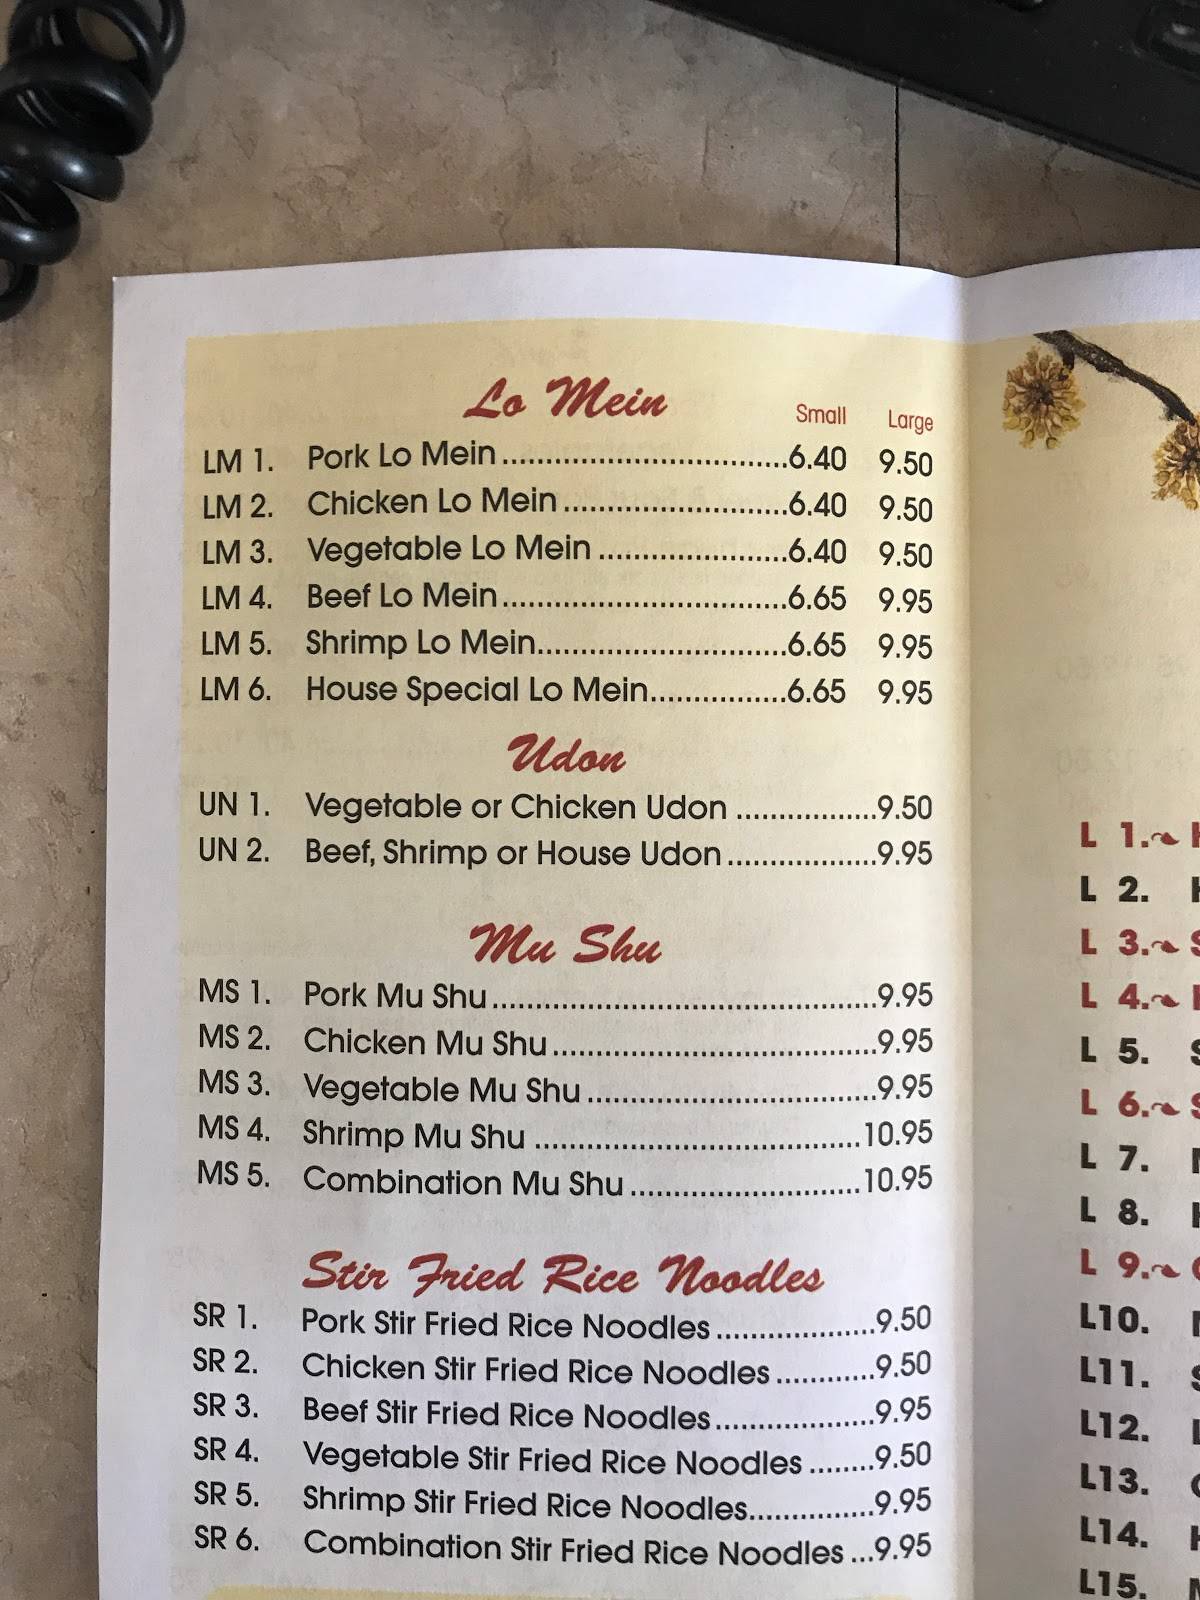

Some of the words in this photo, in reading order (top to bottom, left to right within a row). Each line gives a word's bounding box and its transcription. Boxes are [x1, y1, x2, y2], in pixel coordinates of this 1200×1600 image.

[462, 376, 527, 419] Lo
[545, 375, 669, 419] Mein
[796, 403, 847, 425] Small
[888, 409, 934, 436] Large
[203, 448, 242, 475] LM
[254, 447, 274, 473] 1.
[308, 443, 371, 471] Pork
[379, 442, 412, 468] Lo
[421, 439, 496, 467] Mein
[788, 443, 847, 472] 6.40
[878, 448, 933, 478] 9.50
[203, 493, 242, 520] LM
[250, 492, 273, 519] 2.
[307, 488, 428, 517] Chicken
[438, 487, 472, 514] Lo
[481, 486, 557, 513] Mein
[788, 490, 847, 519] 6.40
[878, 494, 933, 523] 9.50
[202, 539, 241, 565] LM
[249, 538, 273, 565] 3.
[306, 534, 463, 569] Vegetable
[471, 534, 506, 561] Lo
[515, 533, 591, 561] Mein
[788, 537, 847, 565] 6.40
[878, 540, 933, 569] 9.50
[202, 584, 241, 611] LM
[248, 584, 272, 610] 4.
[307, 582, 372, 609] Beef
[379, 581, 414, 608] Lo
[423, 581, 497, 608] Mein
[787, 584, 847, 611] 6.65
[878, 586, 933, 615] 9.95
[201, 630, 240, 656] LM
[248, 630, 272, 657] 5.
[305, 628, 408, 661] Shrimp
[417, 628, 451, 655] Lo
[460, 628, 536, 656] Mein
[787, 630, 847, 658] 6.65
[878, 632, 933, 660] 9.95
[200, 676, 240, 702] LM
[248, 676, 271, 702] 6.
[307, 675, 398, 702] House
[405, 675, 519, 707] Special
[529, 675, 564, 702] Lo
[573, 675, 648, 703] Mein
[787, 677, 846, 704] 6.65
[877, 678, 933, 706] 9.95
[507, 732, 627, 774] Udon
[199, 790, 238, 817] UN
[249, 791, 270, 817] 1.
[304, 791, 463, 825] Vegetable
[471, 798, 503, 819] or
[510, 793, 636, 820] Chicken
[646, 794, 727, 820] Udon
[877, 794, 933, 821] 9.50
[1120, 821, 1149, 849] 1.
[199, 836, 238, 862] UN
[246, 836, 270, 863] 2.
[306, 837, 376, 868] Beef,
[382, 838, 488, 871] Shrimp
[496, 844, 529, 866] or
[537, 839, 631, 866] House
[641, 840, 721, 867] Udon
[877, 840, 933, 866] 9.95
[469, 922, 557, 965] Mu
[572, 923, 663, 964] Shu
[1118, 928, 1150, 957] 3.
[199, 977, 240, 1004] MS
[250, 979, 271, 1005] 1.
[304, 980, 368, 1008] Pork
[377, 982, 423, 1009] Mu
[432, 982, 487, 1010] Shu
[877, 981, 934, 1009] 9.95
[1117, 1037, 1149, 1065] 5.
[198, 1068, 240, 1095] MS
[247, 1070, 270, 1097] 3.
[303, 1072, 460, 1107] Vegetable
[469, 1076, 517, 1103] Mu
[525, 1076, 580, 1104] Shu
[877, 1073, 933, 1101] 9.95
[1118, 1090, 1150, 1118] 6.
[198, 1113, 240, 1141] MS
[246, 1116, 270, 1143] 4.
[302, 1118, 405, 1154] Shrimp
[414, 1122, 462, 1150] Mu
[470, 1123, 525, 1150] Shu
[864, 1118, 933, 1147] 10.95
[197, 1159, 239, 1186] MS
[246, 1161, 270, 1188] 5.
[303, 1164, 502, 1196] Combination
[512, 1170, 560, 1197] Mu
[568, 1170, 623, 1197] Shu
[864, 1164, 933, 1193] 10.95
[301, 1250, 390, 1291] Stir
[407, 1252, 527, 1299] Fried
[542, 1253, 640, 1295] Rice
[657, 1253, 825, 1297] Noodles
[1117, 1250, 1150, 1280] 9.
[192, 1301, 226, 1328] SR
[237, 1303, 257, 1330] 1.
[302, 1307, 367, 1335] Pork
[374, 1309, 417, 1336] Stir
[425, 1310, 498, 1337] Fried
[508, 1311, 573, 1339] Rice
[583, 1313, 711, 1341] Noodles
[876, 1304, 932, 1334] 9.50
[1080, 1301, 1150, 1335] L10.
[192, 1346, 226, 1373] SR
[233, 1348, 258, 1375] 2.
[302, 1352, 425, 1380] Chicken
[434, 1355, 477, 1382] Stir
[485, 1356, 559, 1384] Fried
[568, 1358, 634, 1385] Rice
[643, 1359, 770, 1386] Noodles
[875, 1349, 932, 1379] 9.50
[1079, 1355, 1150, 1389] L11.
[1080, 1408, 1150, 1443] L12.
[193, 1435, 227, 1462] SR
[234, 1437, 259, 1463] 4.
[302, 1440, 460, 1473] Vegetable
[467, 1445, 510, 1471] Stir
[519, 1446, 592, 1474] Fried
[601, 1448, 667, 1476] Rice
[676, 1449, 803, 1476] Noodles
[874, 1440, 932, 1470] 9.50
[1080, 1462, 1149, 1496] L13.
[193, 1479, 227, 1506] SR
[235, 1481, 259, 1508] 5.
[302, 1484, 406, 1518] Shrimp
[413, 1488, 457, 1514] Stir
[464, 1489, 537, 1517] Fried
[547, 1491, 612, 1519] Rice
[621, 1494, 748, 1522] Noodles
[874, 1486, 932, 1516] 9.95
[194, 1524, 227, 1551] SR
[235, 1526, 259, 1552] 6.
[303, 1528, 502, 1560] Combination
[510, 1535, 553, 1562] Stir
[561, 1537, 634, 1565] Fried
[643, 1539, 709, 1566] Rice
[718, 1539, 844, 1567] Noodles
[874, 1531, 932, 1562] 9.95
[1080, 1514, 1149, 1549] L14.
[1079, 1567, 1148, 1600] L15.
